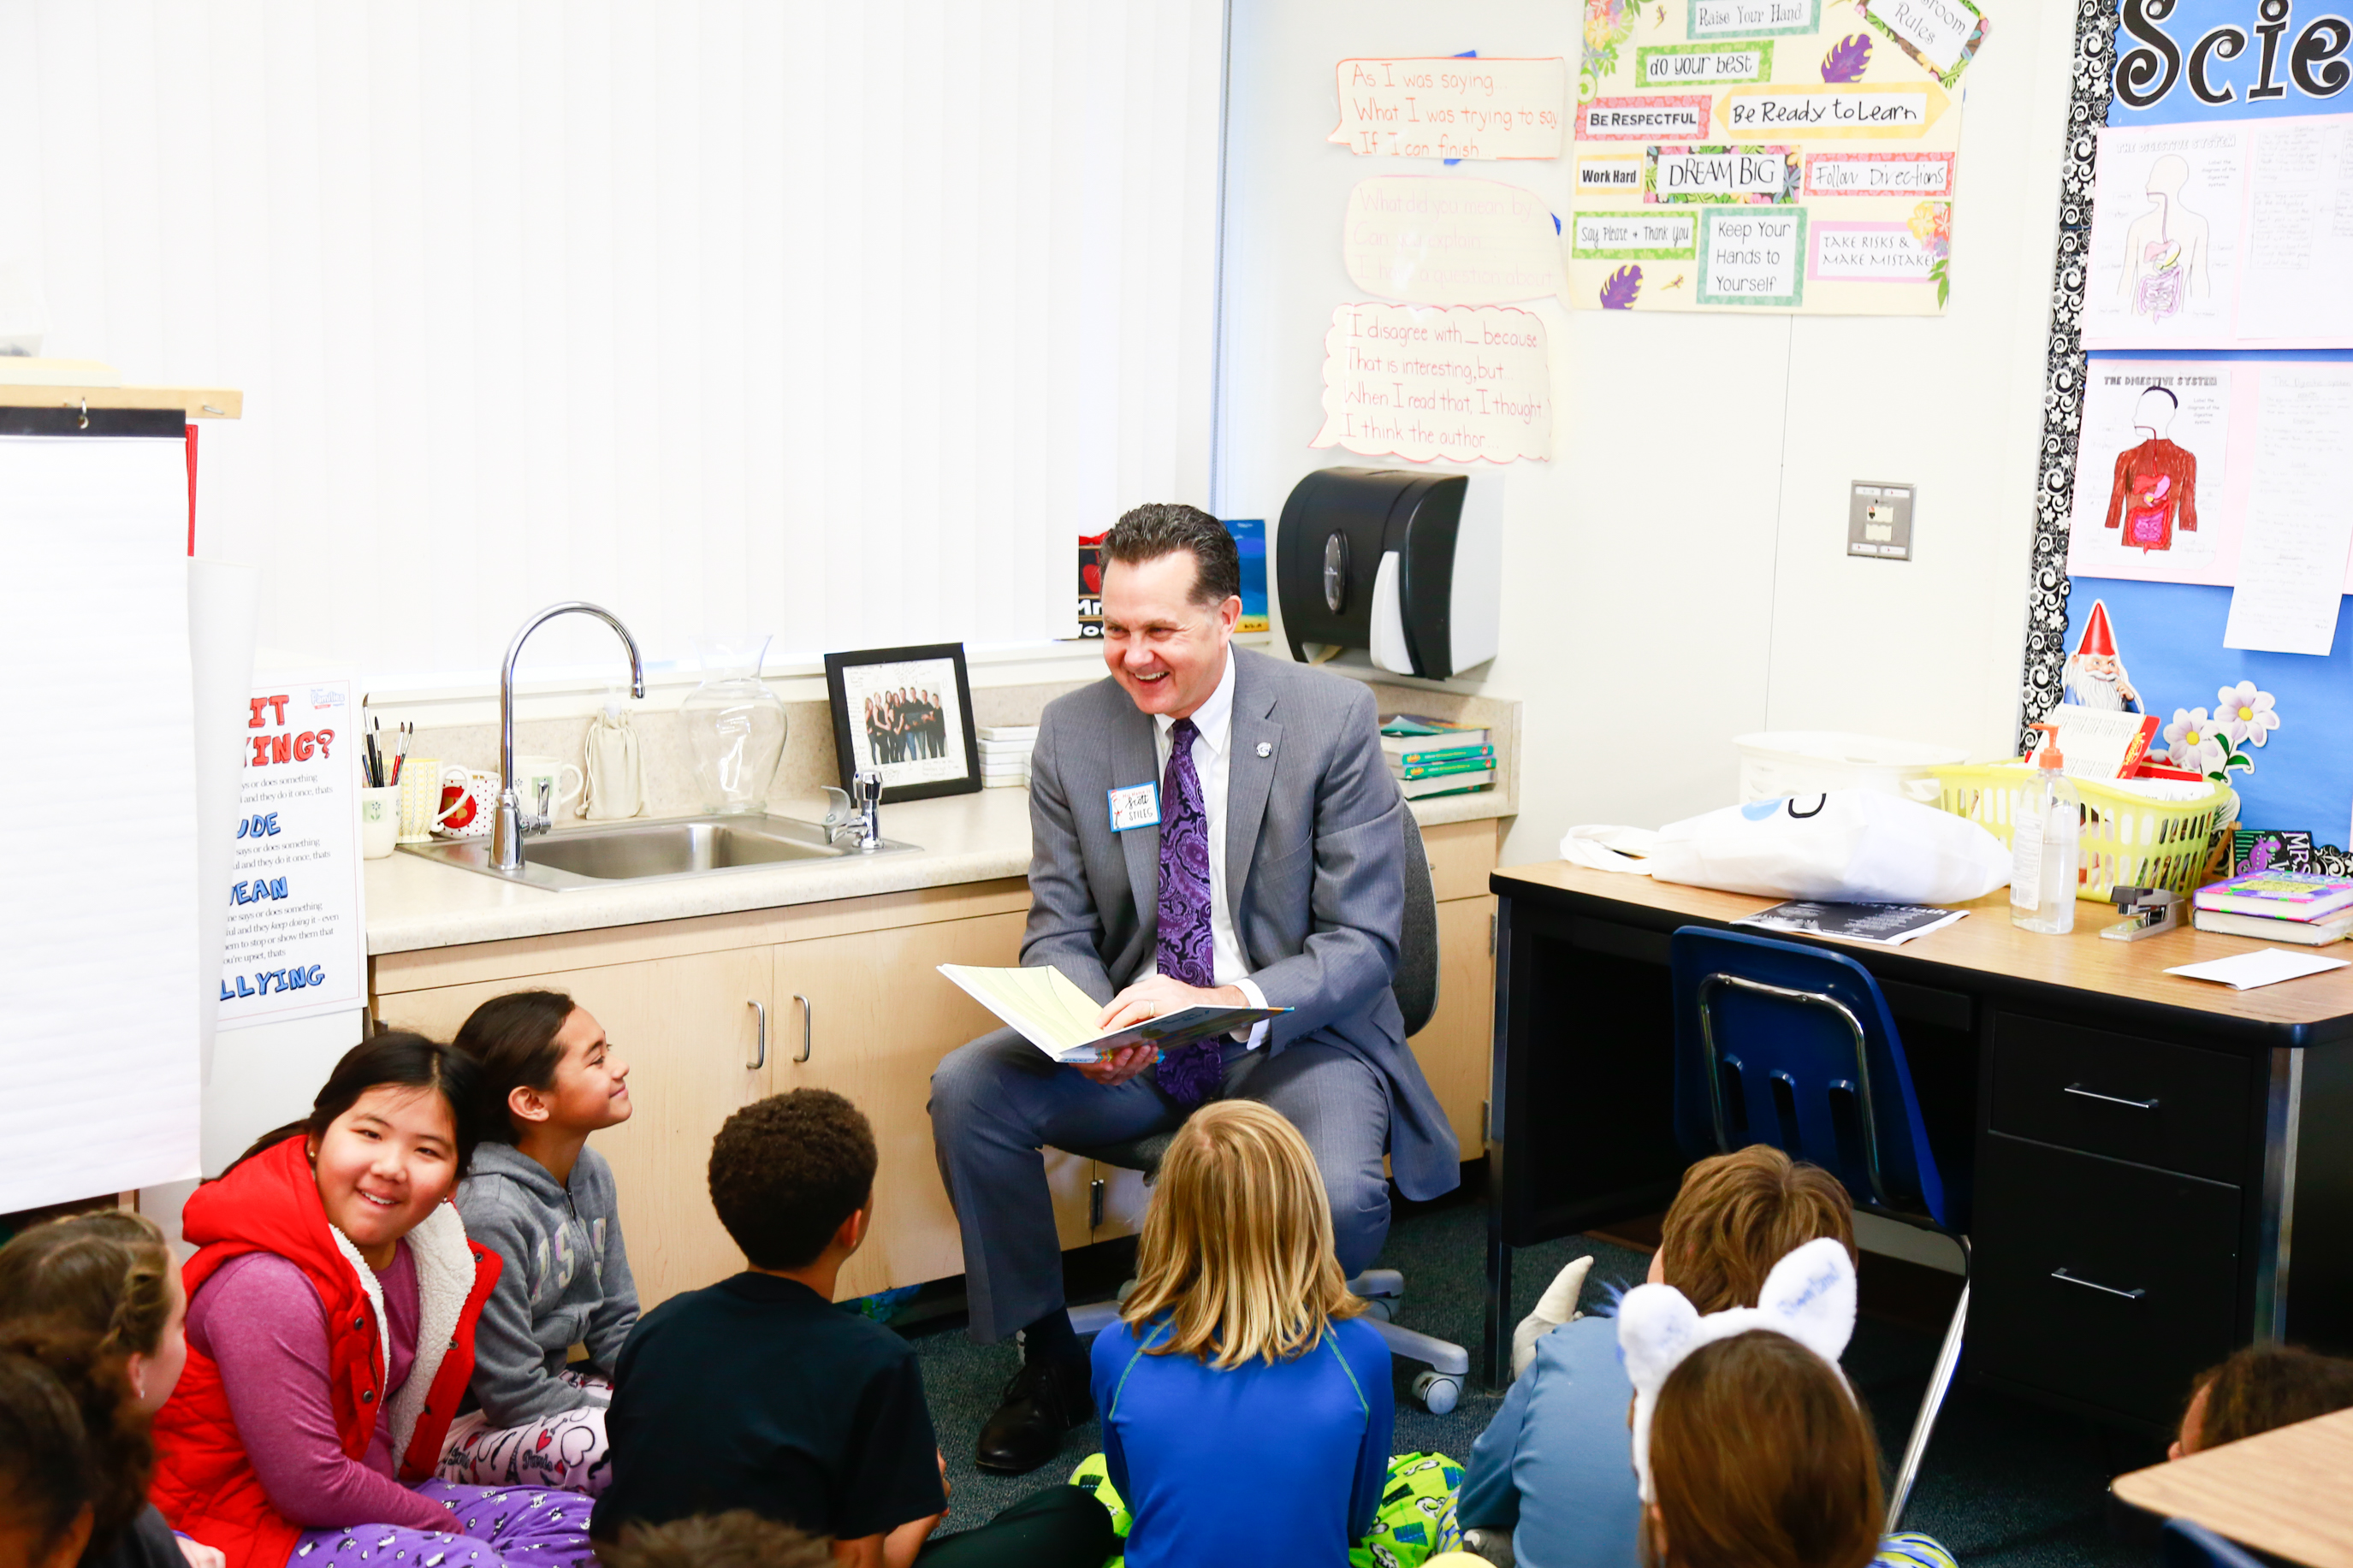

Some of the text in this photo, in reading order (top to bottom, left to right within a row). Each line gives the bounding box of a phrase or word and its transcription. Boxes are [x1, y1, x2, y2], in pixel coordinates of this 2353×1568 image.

[1698, 3, 1802, 27] Raise Your Hand
[1895, 2, 1934, 45] Rules
[1650, 53, 1752, 75] do your best
[2116, 0, 2353, 107] Scie
[1353, 63, 1376, 86] As
[1381, 63, 1396, 86] I
[1403, 74, 1433, 88] was
[1353, 97, 1558, 132] What I was trying to say
[1611, 113, 1697, 127] RESPECTFUL
[1733, 98, 1917, 123] Be Ready to Learn
[1360, 131, 1378, 154] If
[1387, 132, 1401, 156] I
[1405, 144, 1430, 156] can
[2117, 136, 2236, 153] THE DIGESTIVE SYSTEM
[1582, 169, 1637, 183] Work Hard
[1668, 157, 1775, 187] DREAM BIG
[1816, 164, 1945, 188] Follow Directions
[1360, 187, 1532, 223] What did you mean by
[1354, 221, 1389, 246] Can
[1428, 226, 1481, 253] explain
[1581, 226, 1599, 249] Say
[1603, 226, 1628, 241] Please
[1644, 226, 1668, 241] Thank
[1717, 222, 1791, 245] Keep Your
[1823, 236, 1910, 249] TAKE RISKS &
[1716, 248, 1780, 266] Hands to
[1823, 254, 1935, 267] MAKE MISTAKES
[1354, 254, 1369, 280] I
[1420, 269, 1430, 281] a
[1434, 267, 1500, 289] question
[1505, 263, 1552, 287] about
[1716, 275, 1777, 294] Yourself
[1347, 313, 1537, 347] I disagree with because
[1345, 346, 1383, 371] That
[1388, 358, 1398, 373] is
[2104, 376, 2218, 386] THE DIGESTIVE SYSTEM
[1344, 381, 1389, 405] When
[1392, 382, 1404, 408] I
[1408, 389, 1436, 411] read
[1476, 388, 1491, 415] I
[1492, 393, 1542, 424] thought
[1339, 413, 1356, 437] I
[1361, 416, 1404, 441] think
[1409, 419, 1435, 445] the
[249, 695, 289, 728] IT
[261, 778, 277, 787] does
[279, 774, 318, 785] something
[244, 794, 258, 803] and
[260, 792, 276, 802] they
[288, 790, 293, 798] it
[315, 786, 333, 795] thats
[236, 848, 252, 857] says
[263, 843, 280, 852] does
[282, 838, 320, 849] something
[241, 860, 256, 868] and
[258, 858, 273, 868] they
[286, 855, 291, 863] it
[239, 912, 254, 922] says
[265, 908, 282, 917] does
[284, 902, 323, 913] something
[237, 926, 252, 935] and
[253, 923, 270, 933] they
[271, 920, 288, 932] keep
[289, 917, 310, 927] doing
[322, 914, 339, 922] even
[250, 938, 267, 948] stop
[277, 933, 298, 943] show
[299, 931, 318, 940] them
[319, 927, 334, 937] that
[267, 949, 286, 957] thats
